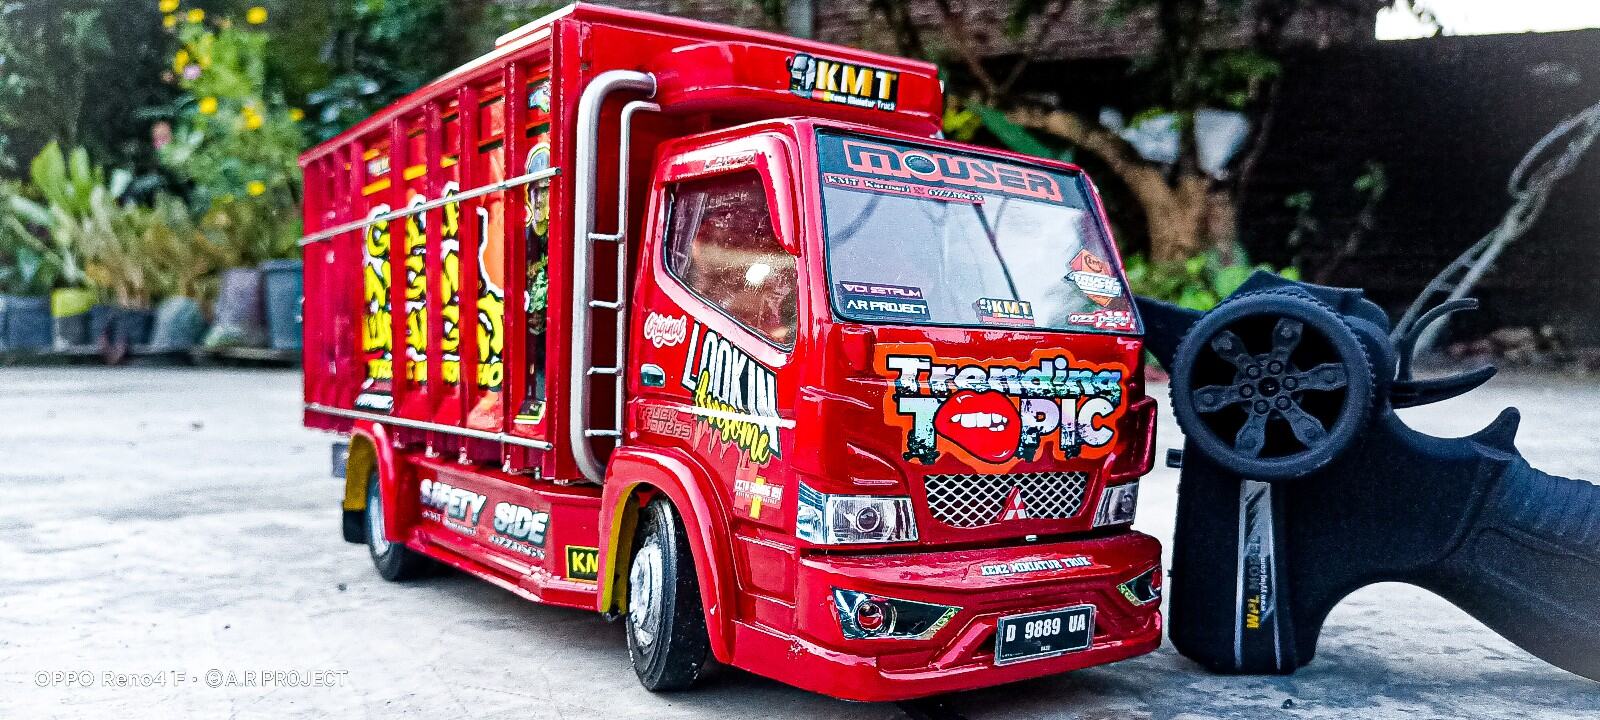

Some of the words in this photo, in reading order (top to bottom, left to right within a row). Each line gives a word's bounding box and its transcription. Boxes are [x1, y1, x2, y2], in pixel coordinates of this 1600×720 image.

[815, 61, 897, 99] KMT
[843, 140, 1063, 201] MOUSER
[846, 299, 869, 311] AR
[869, 301, 927, 315] PROJECT
[643, 311, 687, 348] Original
[886, 355, 1122, 404] Trending
[898, 396, 1116, 464] TOPIC
[420, 478, 488, 526] SAFETY
[493, 501, 550, 546] SIDE
[1005, 624, 1016, 643] D
[1024, 617, 1061, 640] 9889
[1068, 613, 1086, 632] UA
[1247, 595, 1260, 629] WPL
